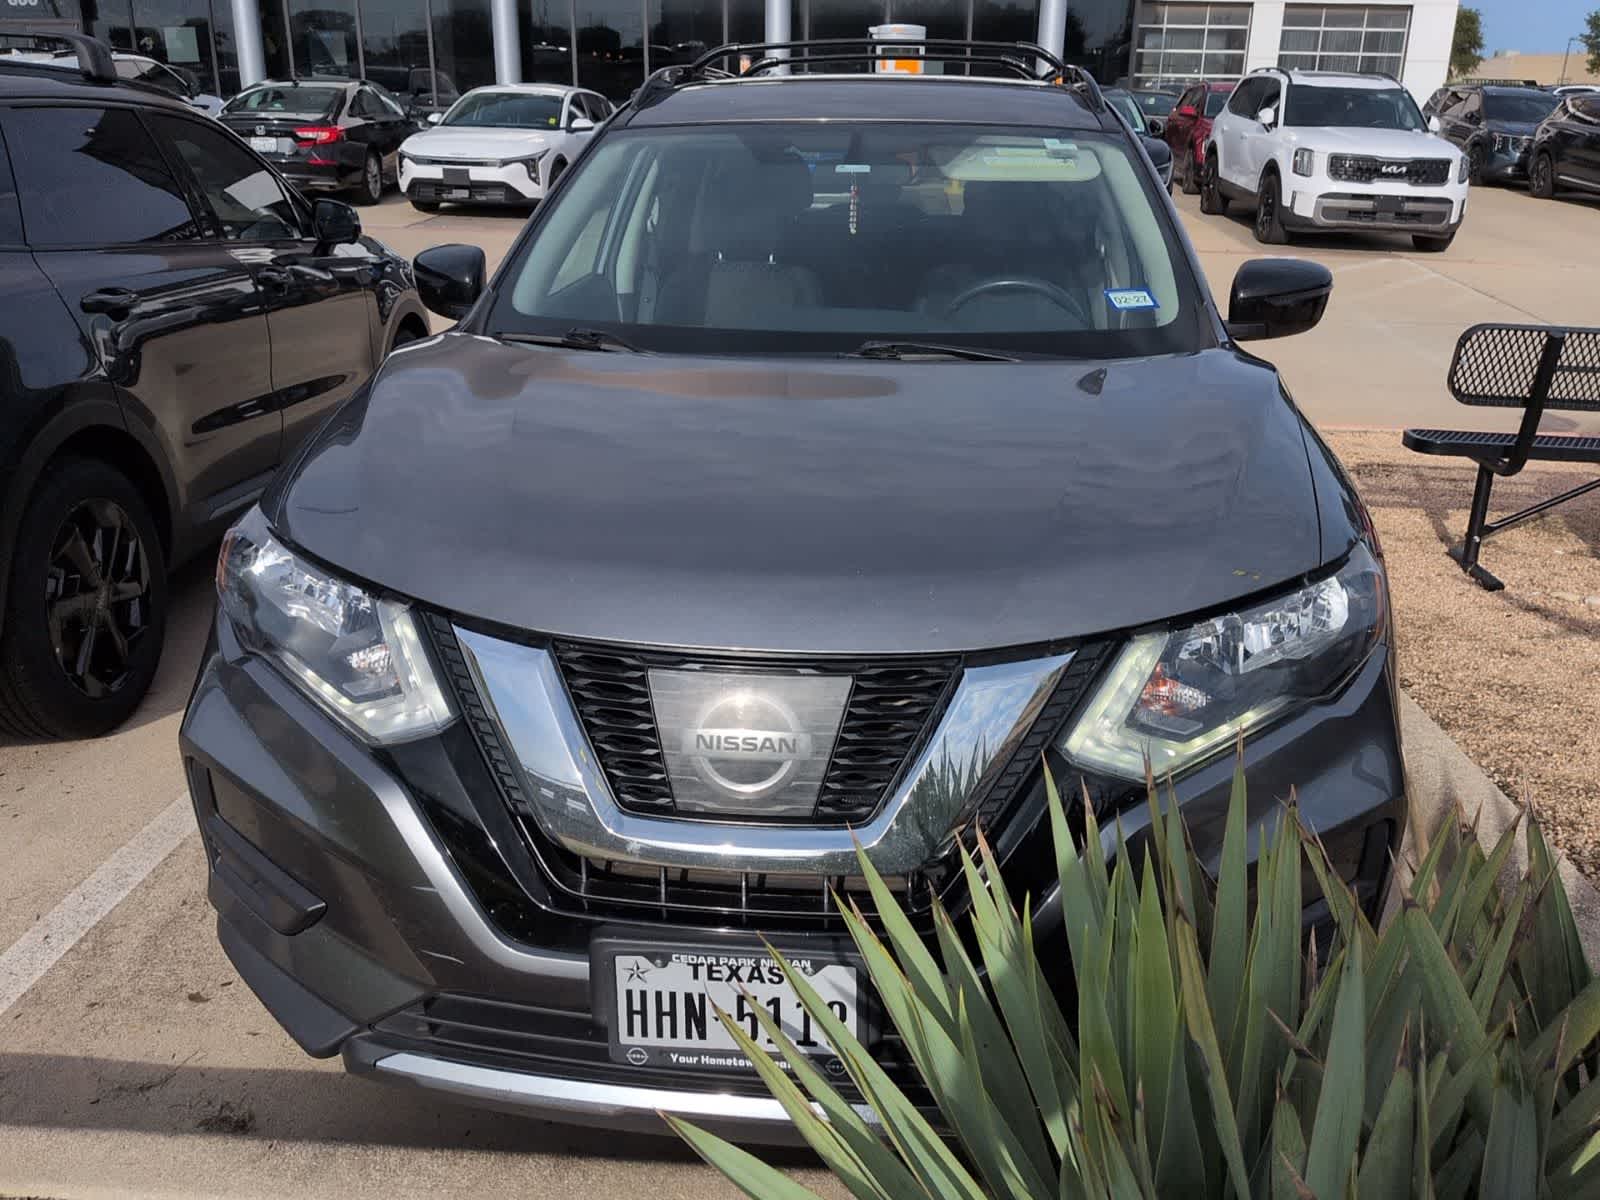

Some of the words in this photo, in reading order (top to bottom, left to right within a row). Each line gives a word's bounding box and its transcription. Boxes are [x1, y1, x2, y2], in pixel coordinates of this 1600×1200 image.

[696, 733, 797, 754] NISSAN
[671, 953, 717, 966] CEDAR
[719, 956, 756, 967] PARK
[687, 963, 785, 985] TEXAS
[669, 1053, 699, 1065] Your
